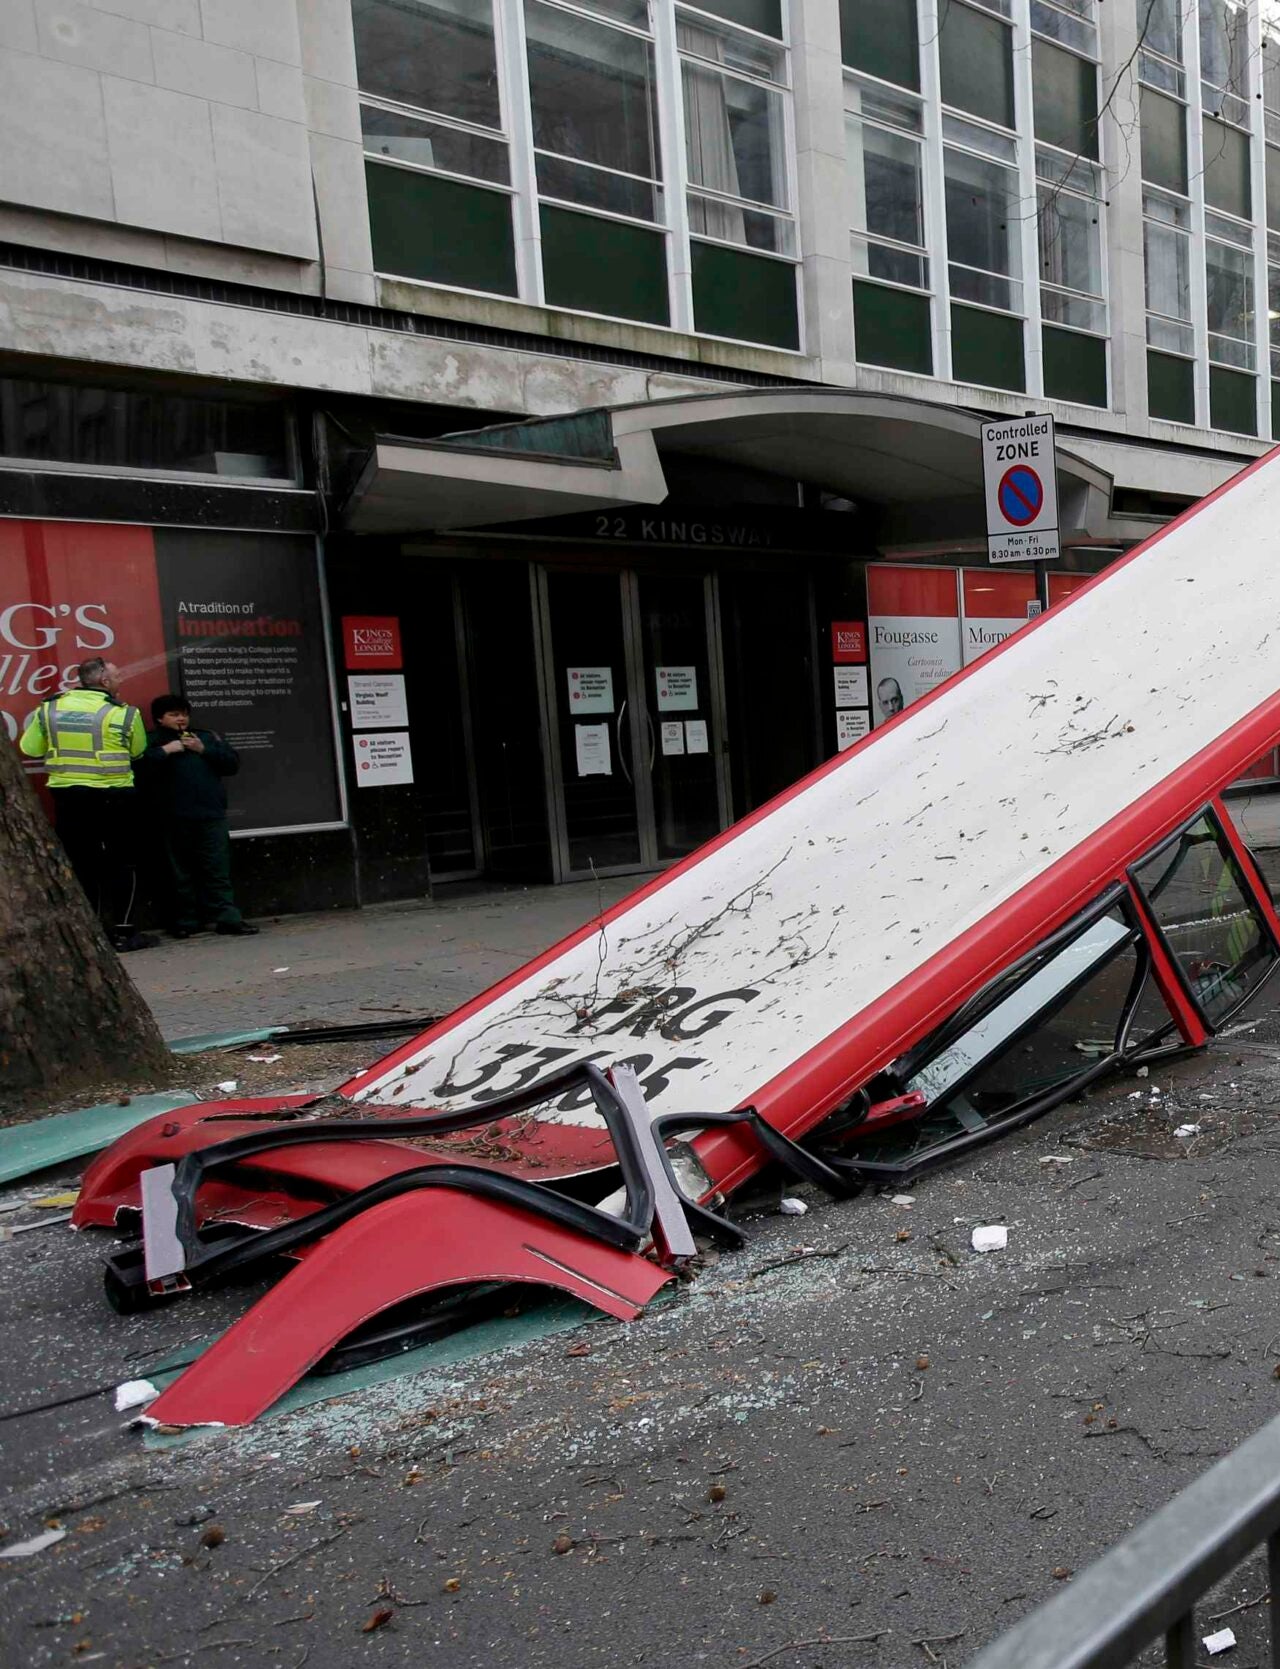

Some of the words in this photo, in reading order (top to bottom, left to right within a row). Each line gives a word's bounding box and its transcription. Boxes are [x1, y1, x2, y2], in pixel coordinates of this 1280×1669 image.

[987, 421, 1048, 441] Controlled
[996, 441, 1039, 461] ZONE
[595, 516, 627, 537] 22
[641, 519, 776, 545] KINGSWAY
[1007, 537, 1023, 546] Mon
[1028, 535, 1039, 544] Fri
[991, 550, 1009, 559] 8.30
[1026, 547, 1044, 556] 6.30
[1045, 547, 1057, 555] pm
[178, 601, 188, 613] A
[188, 602, 240, 613] tradition
[241, 603, 254, 613] of
[874, 626, 939, 647] Fougasse
[354, 644, 394, 652] LONDON
[907, 656, 943, 666] Cartoonist
[0, 654, 81, 697] lleg
[920, 668, 933, 678] and
